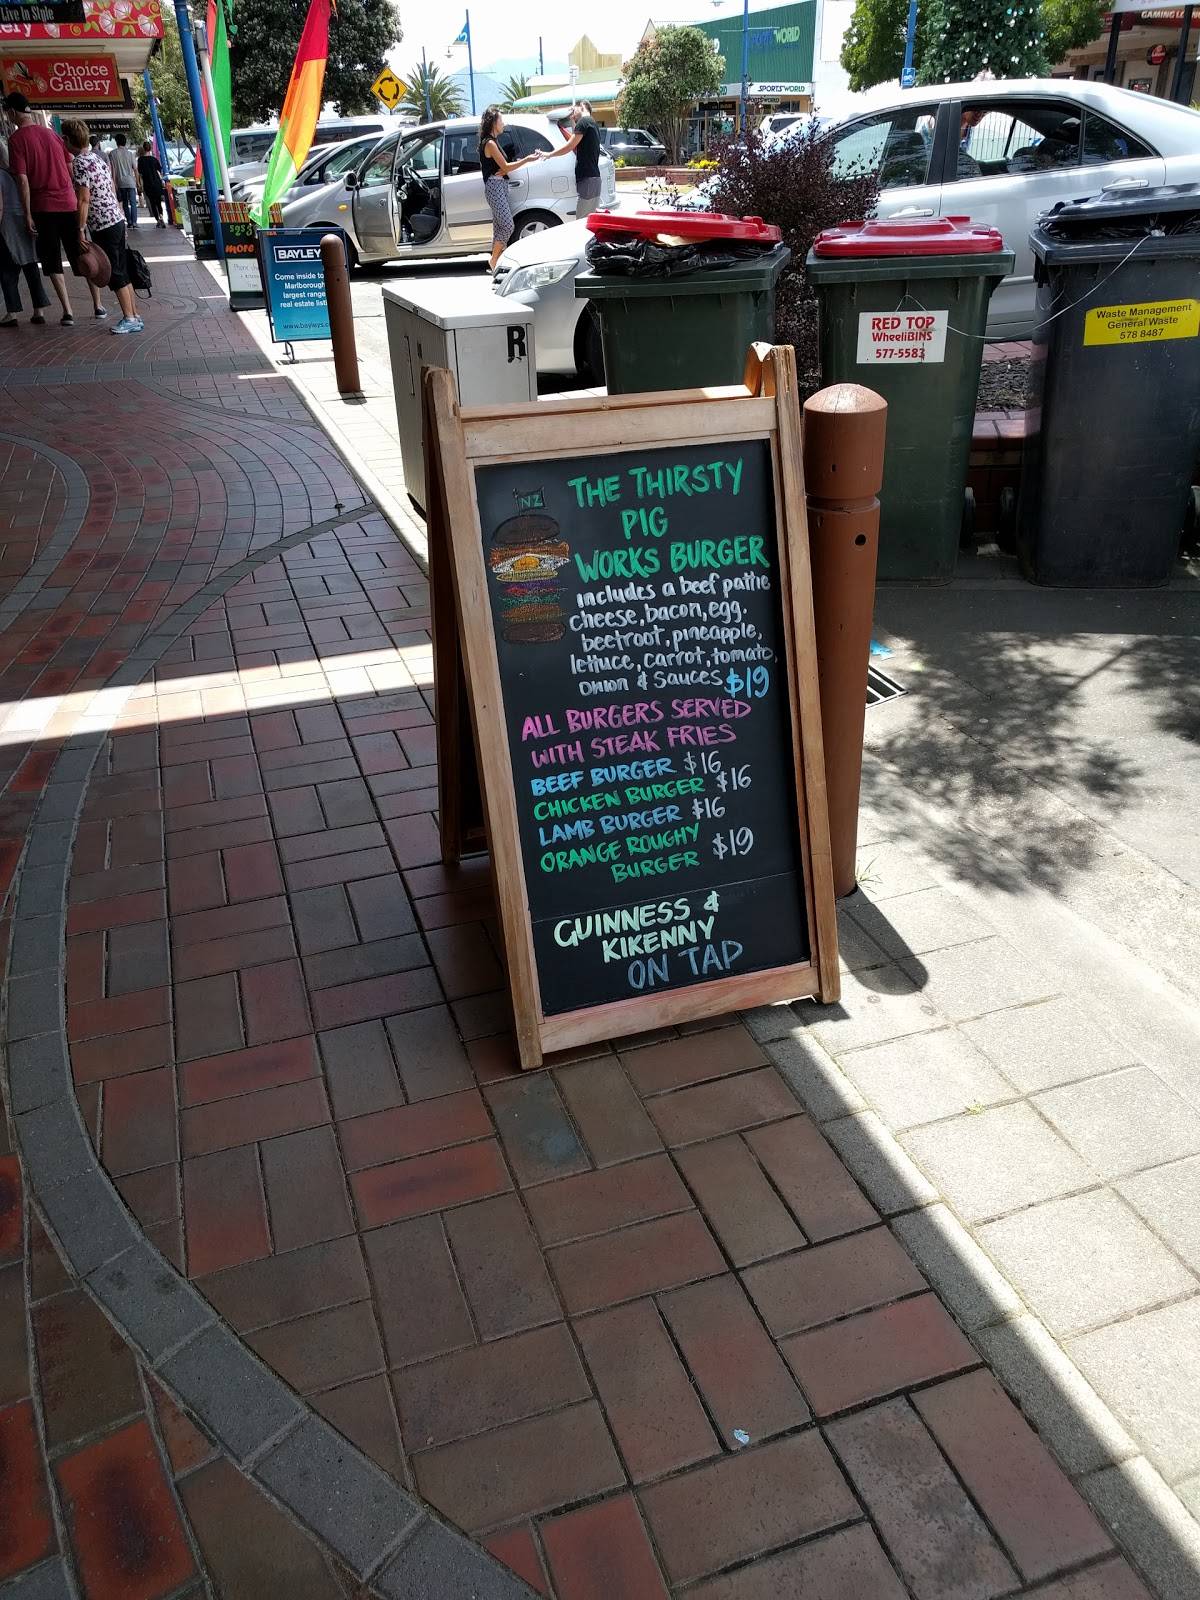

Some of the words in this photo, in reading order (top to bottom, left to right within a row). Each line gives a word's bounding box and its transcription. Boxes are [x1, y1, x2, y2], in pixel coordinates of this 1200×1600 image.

[0, 7, 20, 21] Live
[31, 6, 54, 22] Style
[0, 23, 32, 38] ery
[1141, 10, 1175, 19] GAMING
[50, 77, 110, 95] Gallery
[53, 62, 108, 77] Choice
[274, 273, 294, 281] Come
[296, 272, 316, 280] inside
[284, 282, 326, 290] Marlborough
[283, 291, 306, 299] largest
[307, 291, 326, 299] range
[1096, 310, 1127, 319] Waste
[1129, 304, 1192, 316] Management
[872, 317, 901, 330] RED
[906, 316, 935, 329] TOP
[872, 331, 933, 342] WheeliBINS
[1107, 318, 1146, 329] General
[1149, 317, 1179, 326] Waste
[1120, 331, 1138, 340] 578
[1140, 328, 1164, 338] 8487
[506, 325, 527, 357] R
[567, 475, 621, 508] THE
[628, 456, 743, 499] THIRSTY
[520, 494, 544, 509] NZ
[620, 506, 669, 540] PIG
[574, 547, 661, 584] WORKS
[670, 535, 771, 574] BURGER
[576, 581, 656, 609] includes
[661, 582, 676, 597] a
[679, 572, 720, 596] beef
[722, 571, 771, 598] pattie
[578, 676, 630, 697] onion
[636, 671, 648, 691] &
[723, 664, 770, 699] $19
[521, 713, 560, 742] ALL
[565, 700, 665, 735] BURGERS
[671, 697, 753, 720] SERVED
[531, 740, 585, 769] WITH
[590, 729, 662, 760] STEAK
[666, 723, 738, 749] FRIES
[530, 770, 584, 797] BEEF
[590, 756, 678, 788] BURGER
[683, 750, 723, 775] $16
[533, 790, 622, 821] CHICKEN
[624, 777, 706, 805] BURGER
[716, 764, 753, 793] $16
[538, 819, 596, 848] LAMB
[599, 804, 684, 836] BURGER
[691, 796, 727, 820] $16
[540, 840, 622, 873] ORANGE
[625, 822, 700, 857] ROUGHY
[711, 826, 755, 860] $19
[610, 850, 700, 885] BURGER
[553, 897, 692, 948] GUINNESS
[702, 890, 720, 914] &
[601, 915, 716, 964] KIKENNY
[627, 953, 671, 990] ON
[680, 939, 744, 976] TAP
